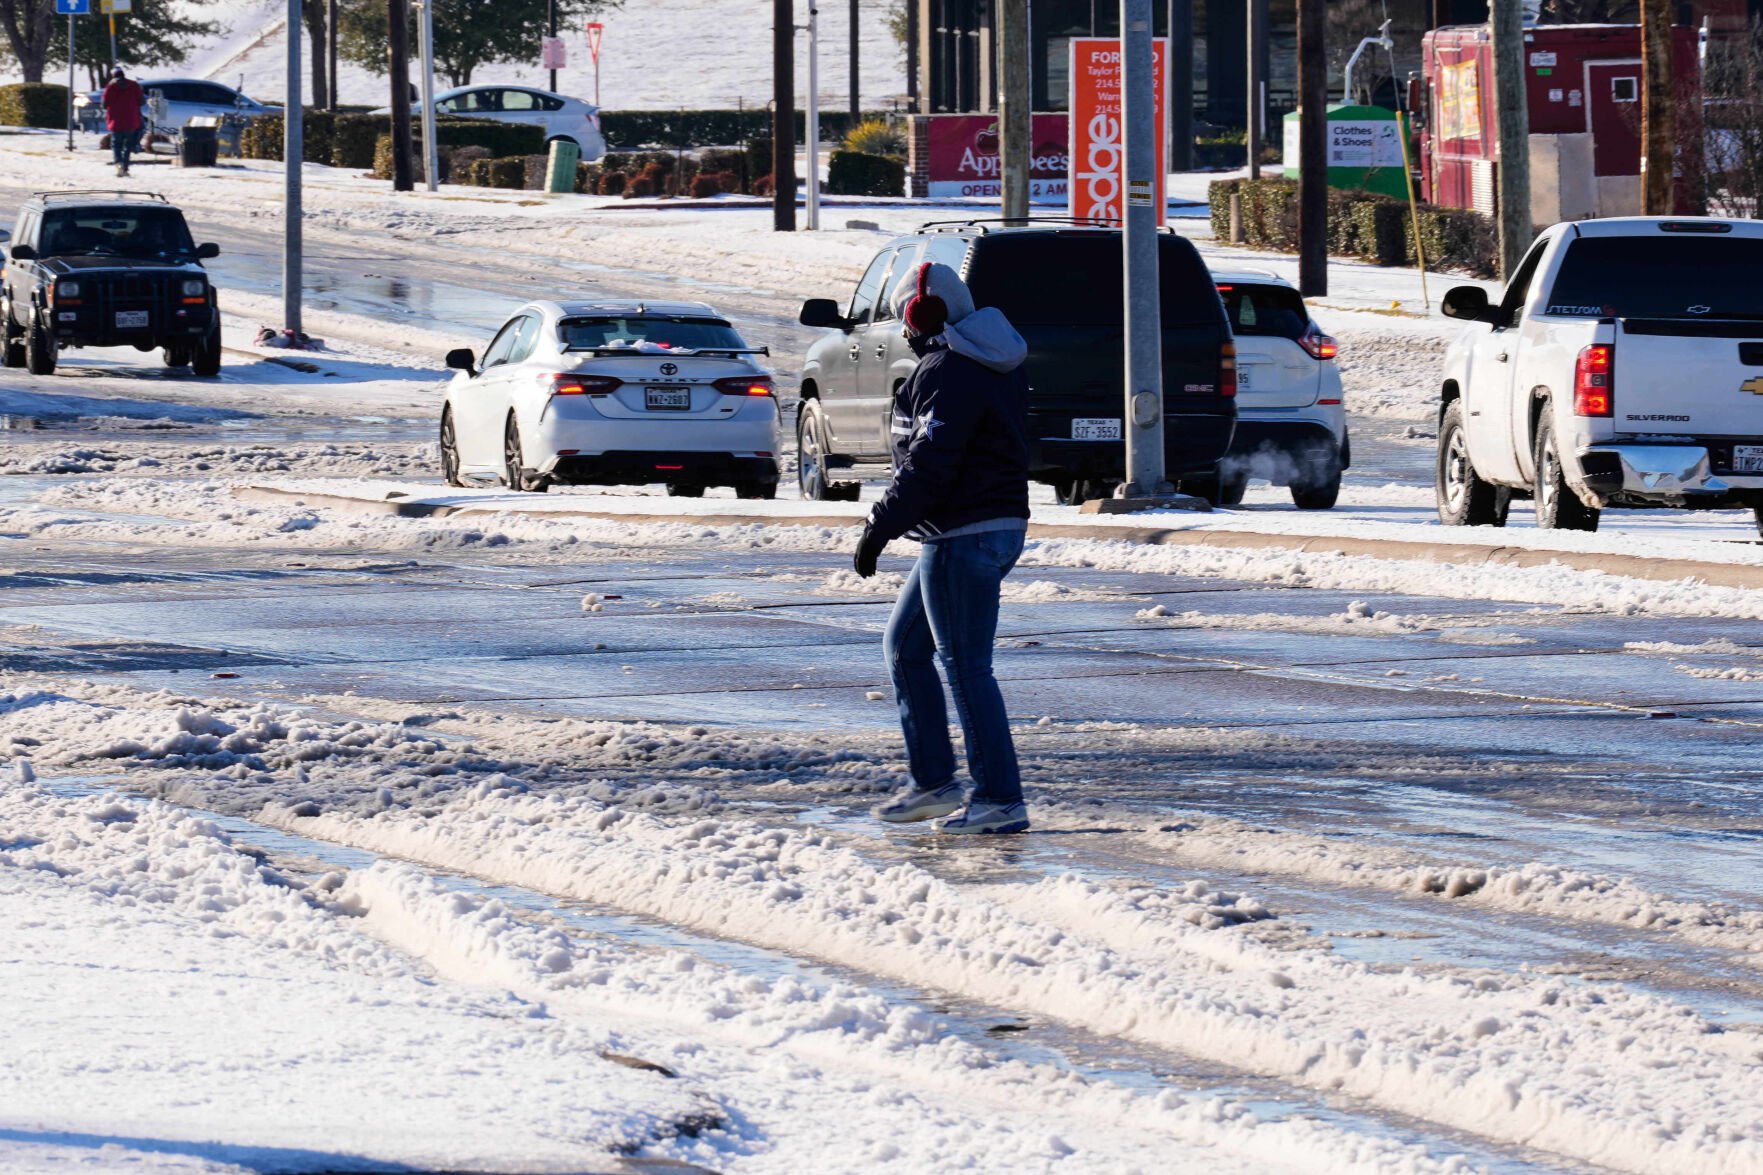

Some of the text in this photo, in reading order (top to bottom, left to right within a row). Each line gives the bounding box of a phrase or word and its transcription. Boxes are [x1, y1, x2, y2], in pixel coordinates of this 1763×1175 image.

[1091, 52, 1121, 64] FOR
[1087, 66, 1113, 77] Taylor
[1333, 126, 1373, 136] Clothes
[1333, 137, 1373, 147] & Shoes
[957, 146, 1069, 176] Appee's
[961, 183, 1068, 196] OPEN 2 AM
[1626, 414, 1690, 422] SILVERADO
[1074, 426, 1119, 439] SZF-3552
